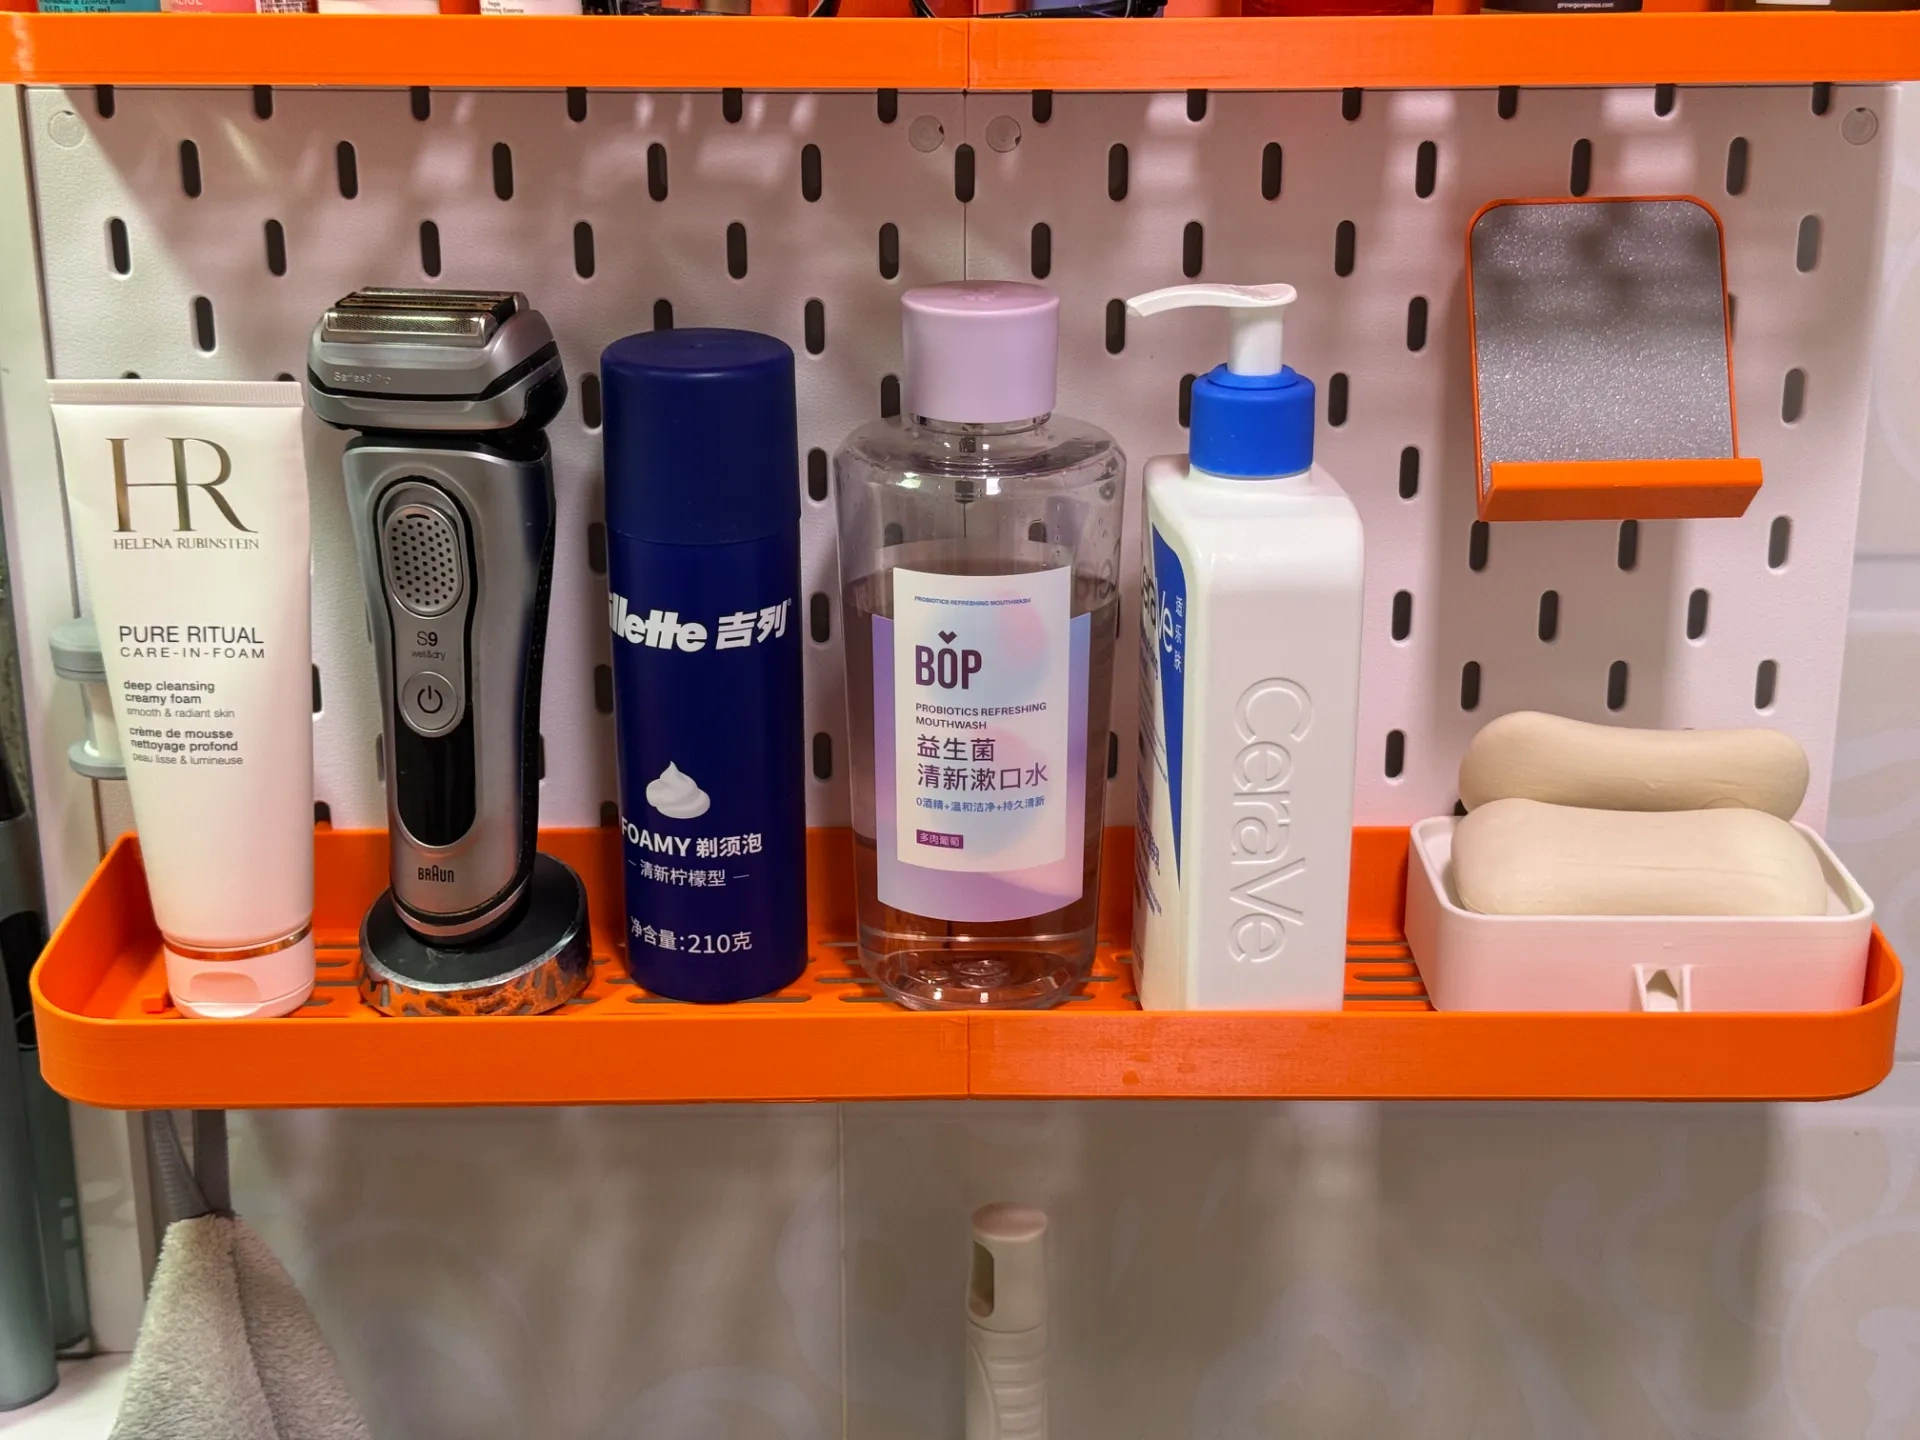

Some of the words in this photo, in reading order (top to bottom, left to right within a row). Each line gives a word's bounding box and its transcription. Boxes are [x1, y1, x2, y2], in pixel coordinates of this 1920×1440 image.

[105, 437, 259, 534] HR
[114, 537, 173, 550] HELENA
[176, 537, 259, 550] RUBINSTEIN
[914, 595, 950, 606] PROBIOTICS
[950, 599, 990, 607] REFRESHING
[990, 597, 1032, 606] MOUTHWASH
[609, 592, 708, 652] illette
[715, 599, 788, 650] 吉列
[119, 625, 180, 643] PURE
[187, 625, 265, 644] RITUAL
[416, 630, 438, 647] S9
[120, 646, 265, 659] CARE-IN-FOAM
[123, 680, 152, 692] deep
[156, 681, 215, 694] cleansing
[125, 693, 167, 706] creamy
[170, 693, 202, 704] foam
[127, 707, 162, 718] smooth
[164, 708, 173, 718] &
[175, 708, 211, 718] radiant
[213, 708, 235, 718] skin
[915, 702, 979, 716] PROBIOTICS
[981, 701, 1047, 717] REFRESHING
[915, 716, 987, 730] MOUTHWASH
[129, 725, 162, 738] crème
[165, 728, 181, 739] de
[185, 730, 234, 739] mousse
[131, 739, 186, 753] nettoyage
[189, 741, 238, 753] profond
[917, 734, 996, 763] 益生菌
[132, 753, 153, 763] peau
[155, 753, 177, 765] lisse
[179, 755, 188, 765] &
[190, 755, 244, 766] lumineuse
[917, 763, 1048, 792] 清新漱口水
[1228, 676, 1315, 963] CeraVe
[621, 816, 692, 857] FOAMY
[695, 833, 763, 859] 剃须泡
[919, 831, 961, 848] 多肉葡萄
[417, 865, 455, 883] BRAUN
[639, 859, 727, 888] 清新柠檬型
